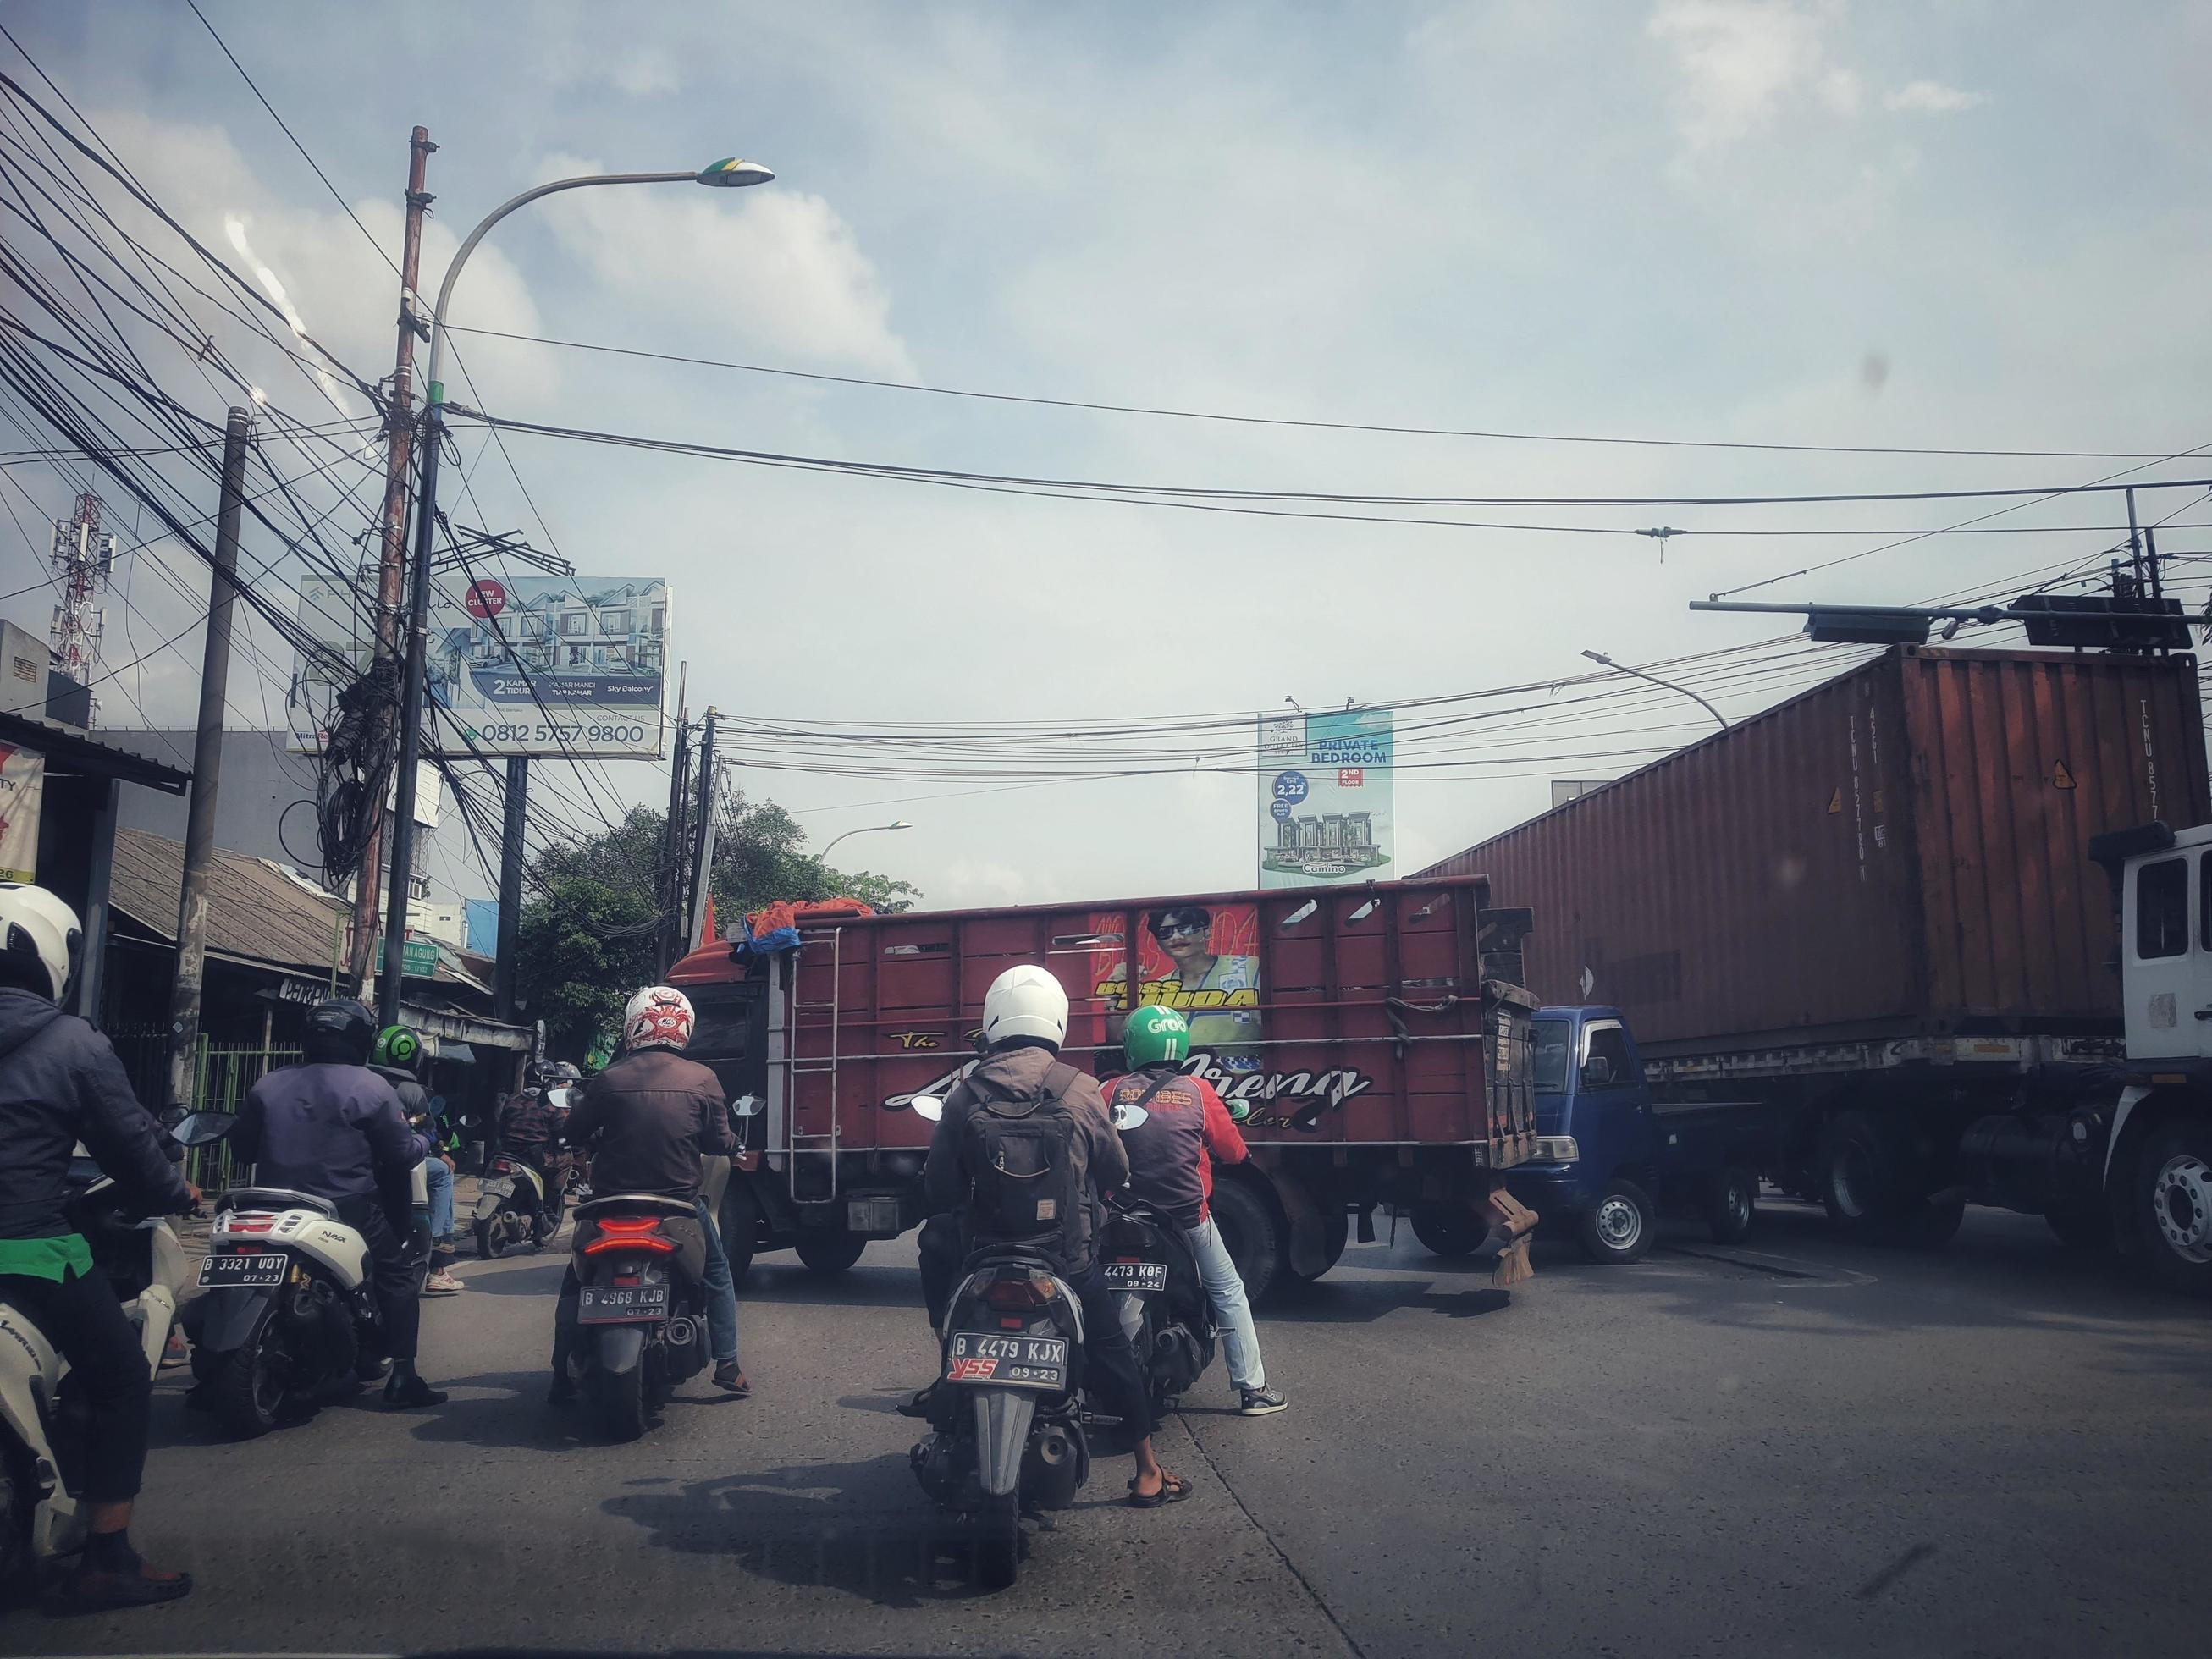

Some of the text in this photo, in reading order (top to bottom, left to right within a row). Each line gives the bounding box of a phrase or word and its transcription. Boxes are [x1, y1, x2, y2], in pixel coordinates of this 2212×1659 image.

[467, 597, 502, 606] CLUTER
[493, 679, 505, 695] 2
[607, 685, 621, 693] Sky
[482, 725, 644, 742] 0812 5757 9800
[2140, 699, 2153, 758] TCNU
[1319, 740, 1379, 751] PRIVATE
[1311, 752, 1387, 763] BEDROOM
[1303, 863, 1345, 873] Camino
[414, 947, 435, 960] AGUNG
[1147, 1017, 1187, 1033] Grab
[889, 1031, 946, 1048] The
[204, 1259, 212, 1270] B
[218, 1258, 250, 1270] 3321
[1104, 1265, 1134, 1277] 4473
[585, 1292, 593, 1305] B
[639, 1290, 664, 1303] KJB
[957, 1337, 1062, 1363] B 4479 KJX
